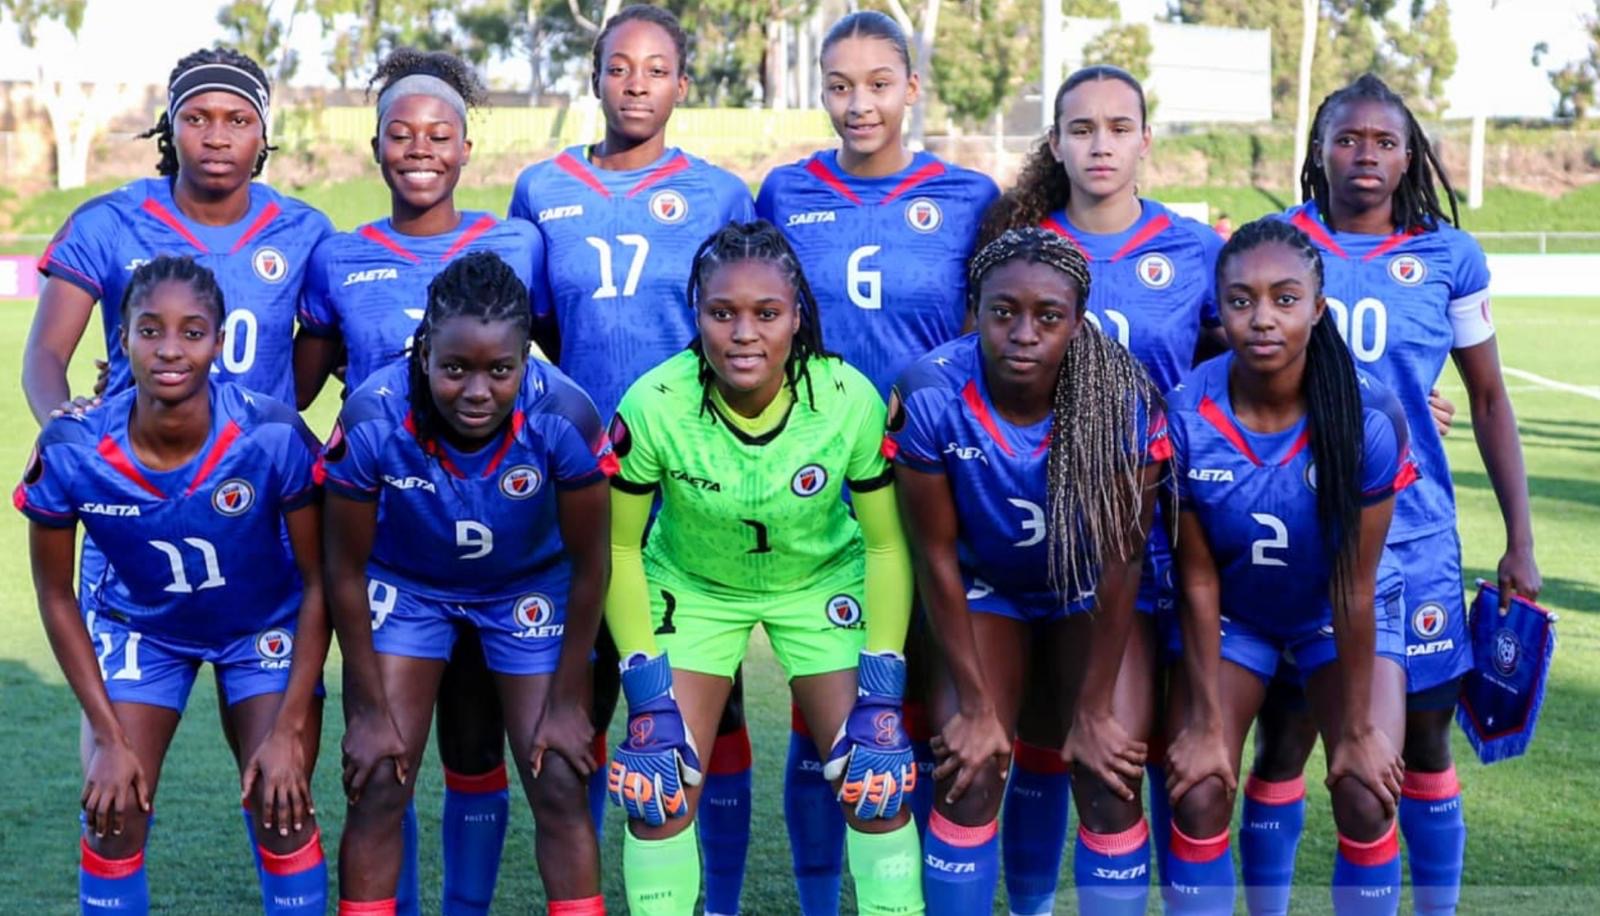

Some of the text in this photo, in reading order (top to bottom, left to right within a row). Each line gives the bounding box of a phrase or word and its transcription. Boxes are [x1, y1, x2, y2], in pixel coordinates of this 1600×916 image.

[538, 204, 585, 223] SAETA
[785, 210, 837, 228] SAETA
[343, 267, 398, 286] SAETA
[585, 233, 650, 299] 17
[846, 244, 882, 310] 6
[211, 308, 258, 374] 0
[1187, 467, 1234, 482] AETA
[79, 501, 141, 517] SAETA
[1007, 497, 1047, 548] 3
[455, 519, 494, 560] 9
[738, 518, 773, 554] 1
[1251, 512, 1289, 567] 2
[147, 536, 227, 594] 11
[367, 578, 398, 631] 9
[653, 588, 677, 635] 1
[1406, 639, 1454, 657] SAETA
[924, 855, 976, 874] SAETA
[1092, 863, 1147, 881] SAETA
